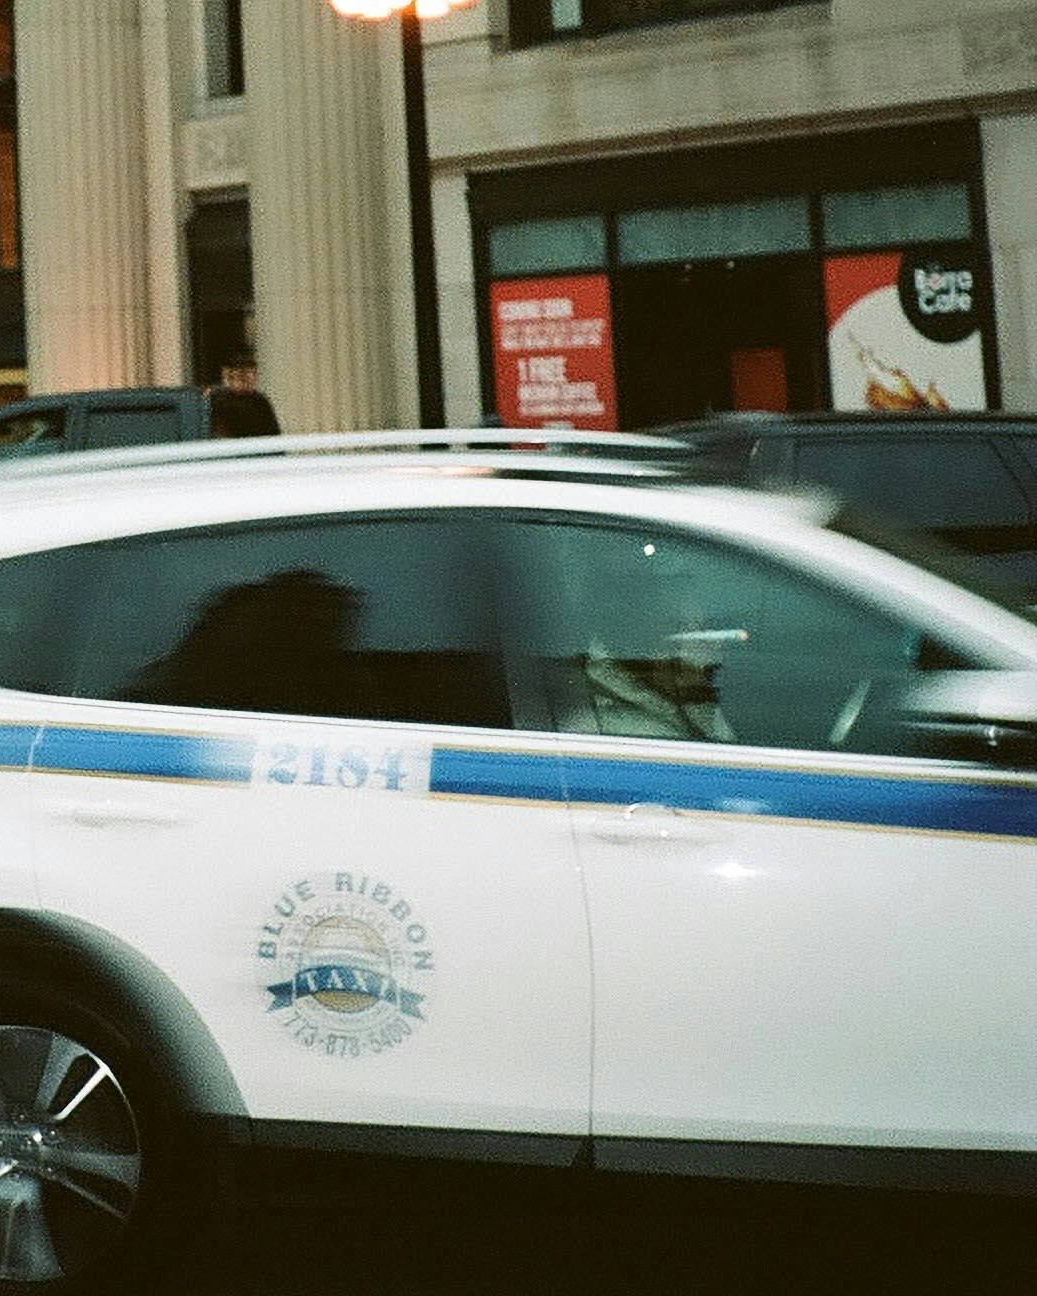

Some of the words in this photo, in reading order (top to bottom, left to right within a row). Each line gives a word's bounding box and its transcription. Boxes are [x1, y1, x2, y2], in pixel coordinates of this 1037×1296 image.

[266, 742, 409, 793] 2184
[256, 878, 317, 961] BLUE
[334, 871, 436, 972] RIBBON
[300, 969, 391, 998] TAXI
